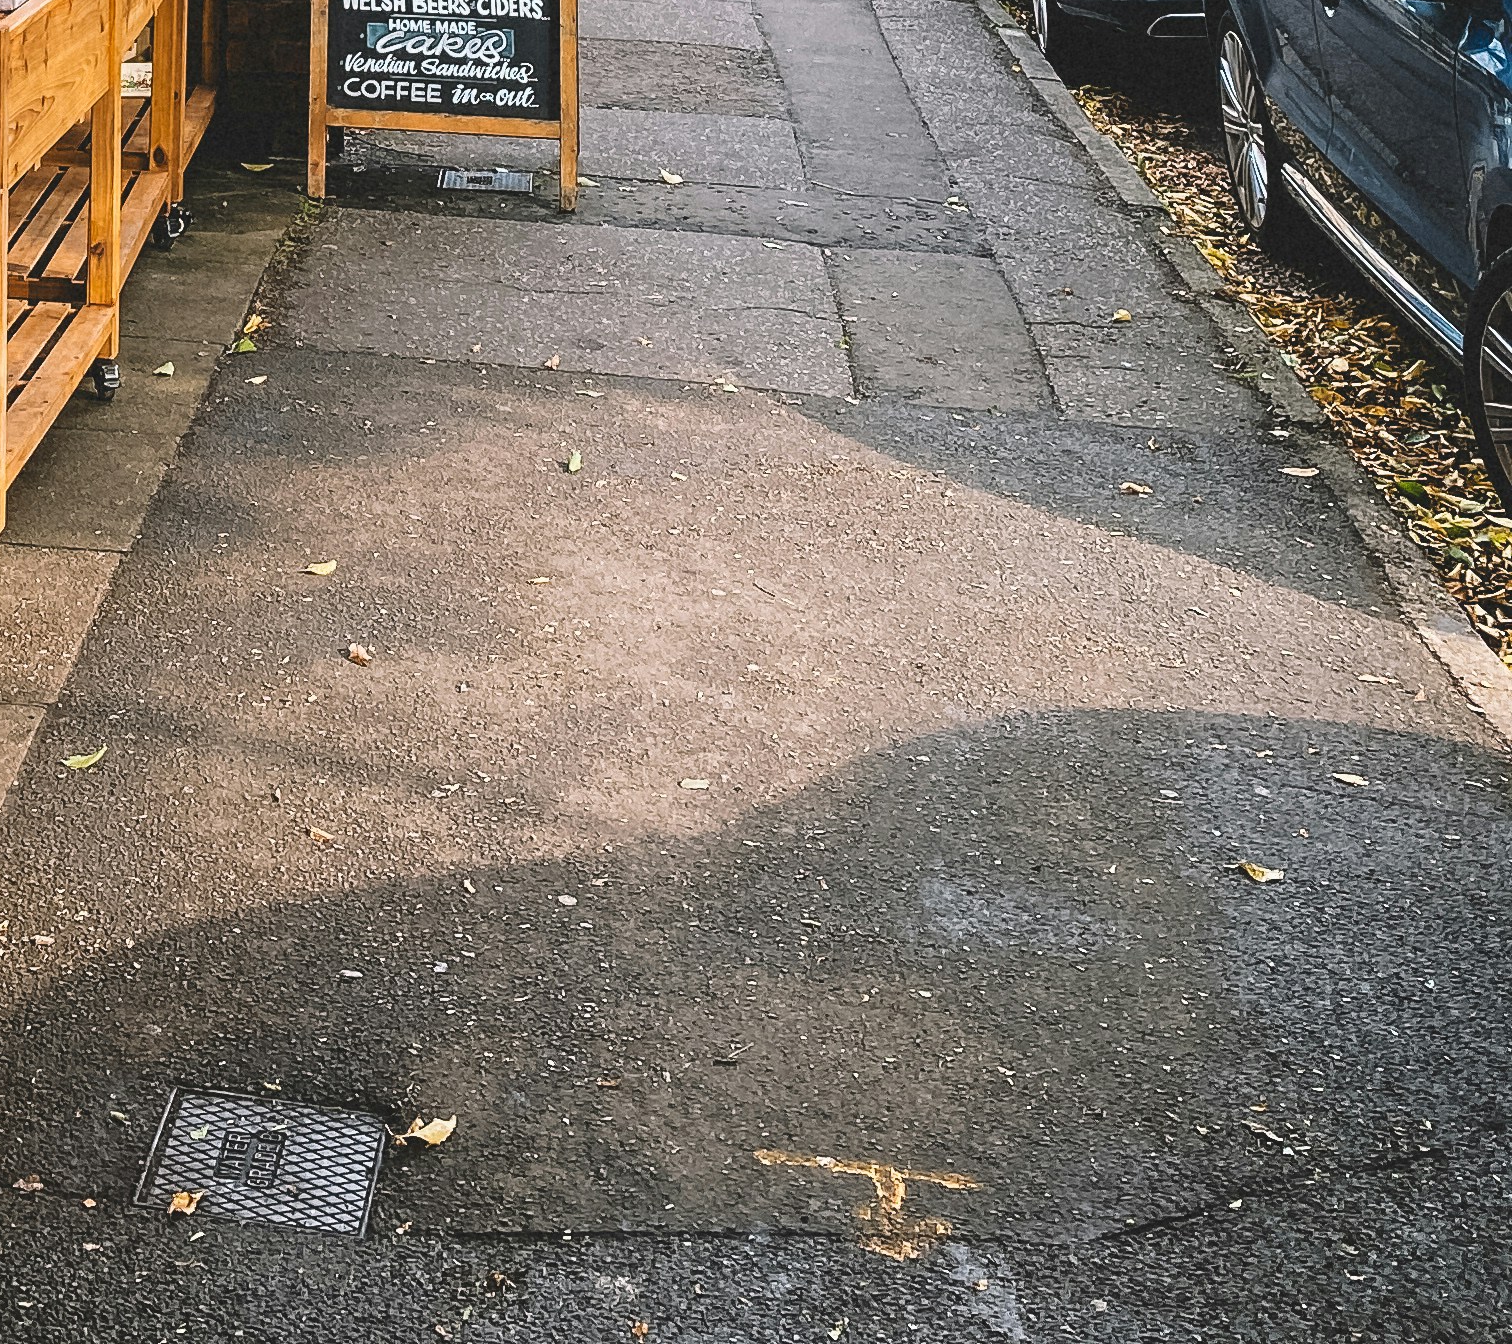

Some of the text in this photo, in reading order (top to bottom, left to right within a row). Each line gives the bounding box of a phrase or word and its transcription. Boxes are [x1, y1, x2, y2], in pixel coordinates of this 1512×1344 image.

[344, 52, 418, 75] Venetian
[343, 78, 443, 103] COFFEE
[451, 83, 480, 105] in
